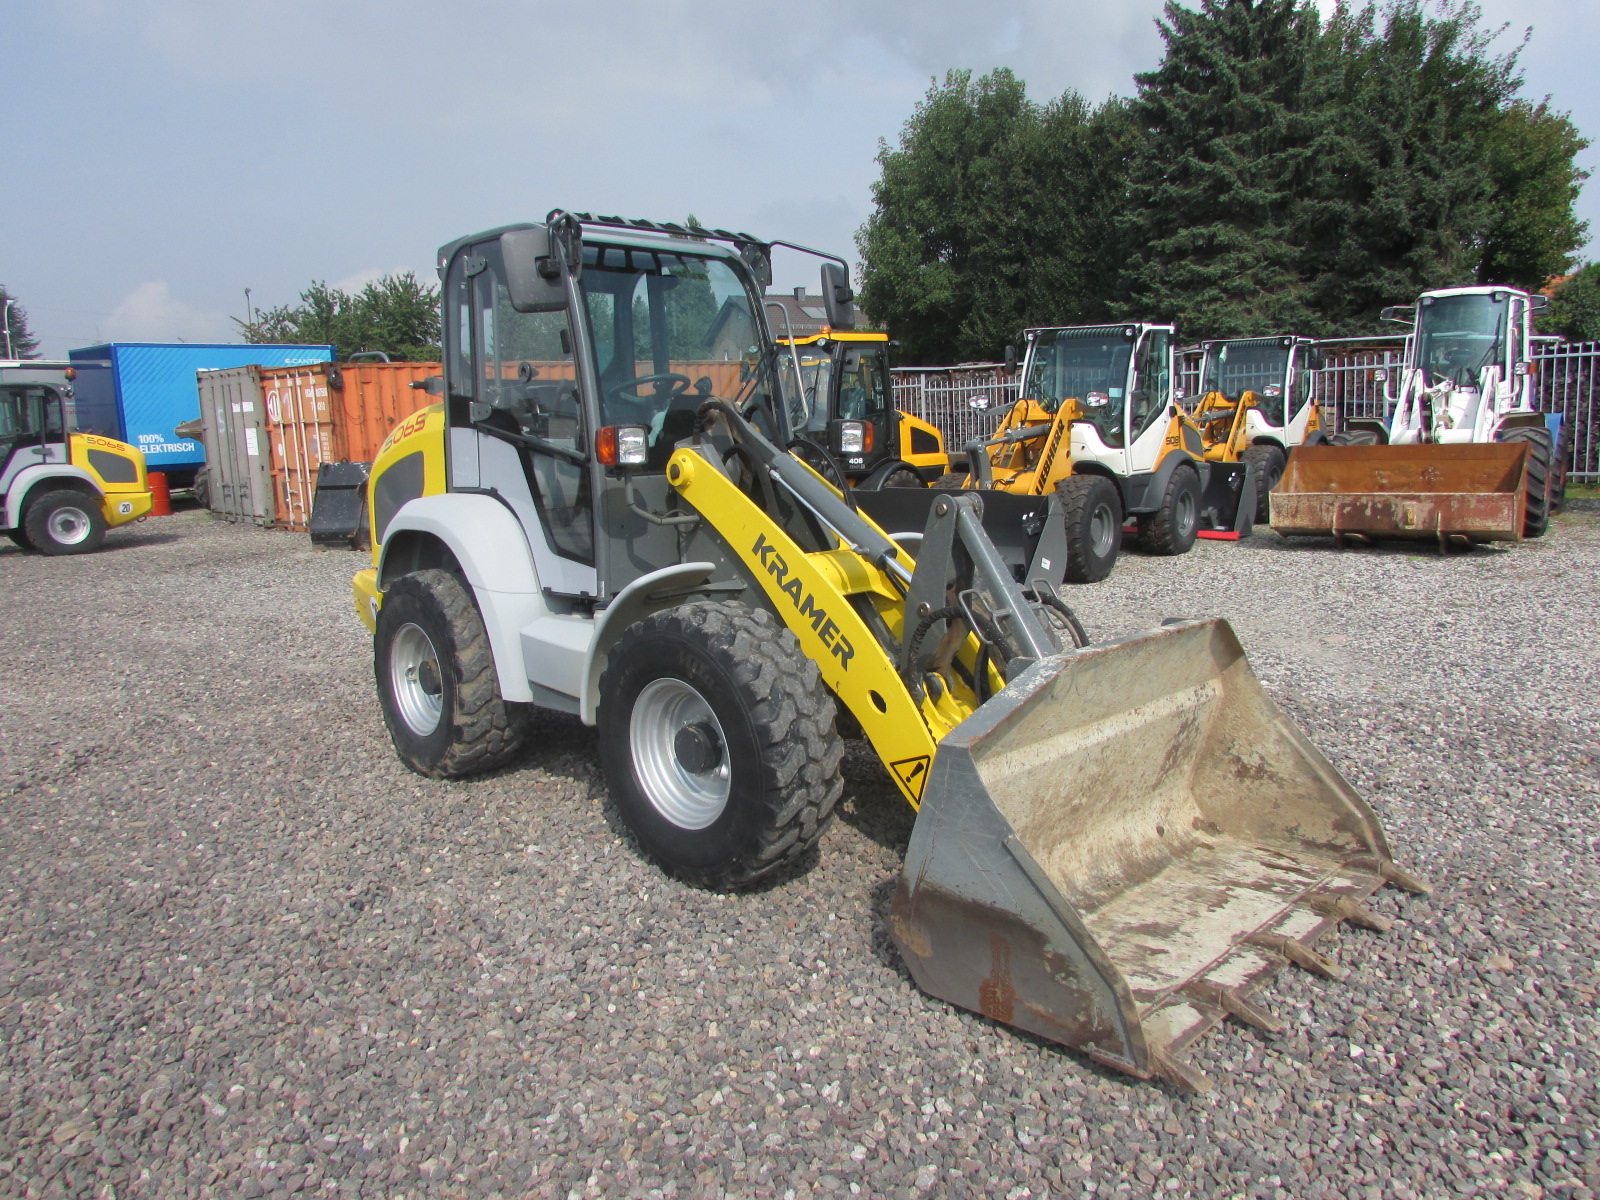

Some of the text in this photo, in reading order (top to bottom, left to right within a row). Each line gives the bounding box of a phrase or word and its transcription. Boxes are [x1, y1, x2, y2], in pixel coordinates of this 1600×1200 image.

[138, 434, 165, 443] 100%
[383, 413, 426, 453] 5065
[87, 437, 126, 452] 5065
[140, 443, 195, 454] ELEKTRISCH
[1035, 419, 1065, 495] LIEBHERR
[121, 503, 131, 513] 20
[752, 533, 855, 672] KRAMER
